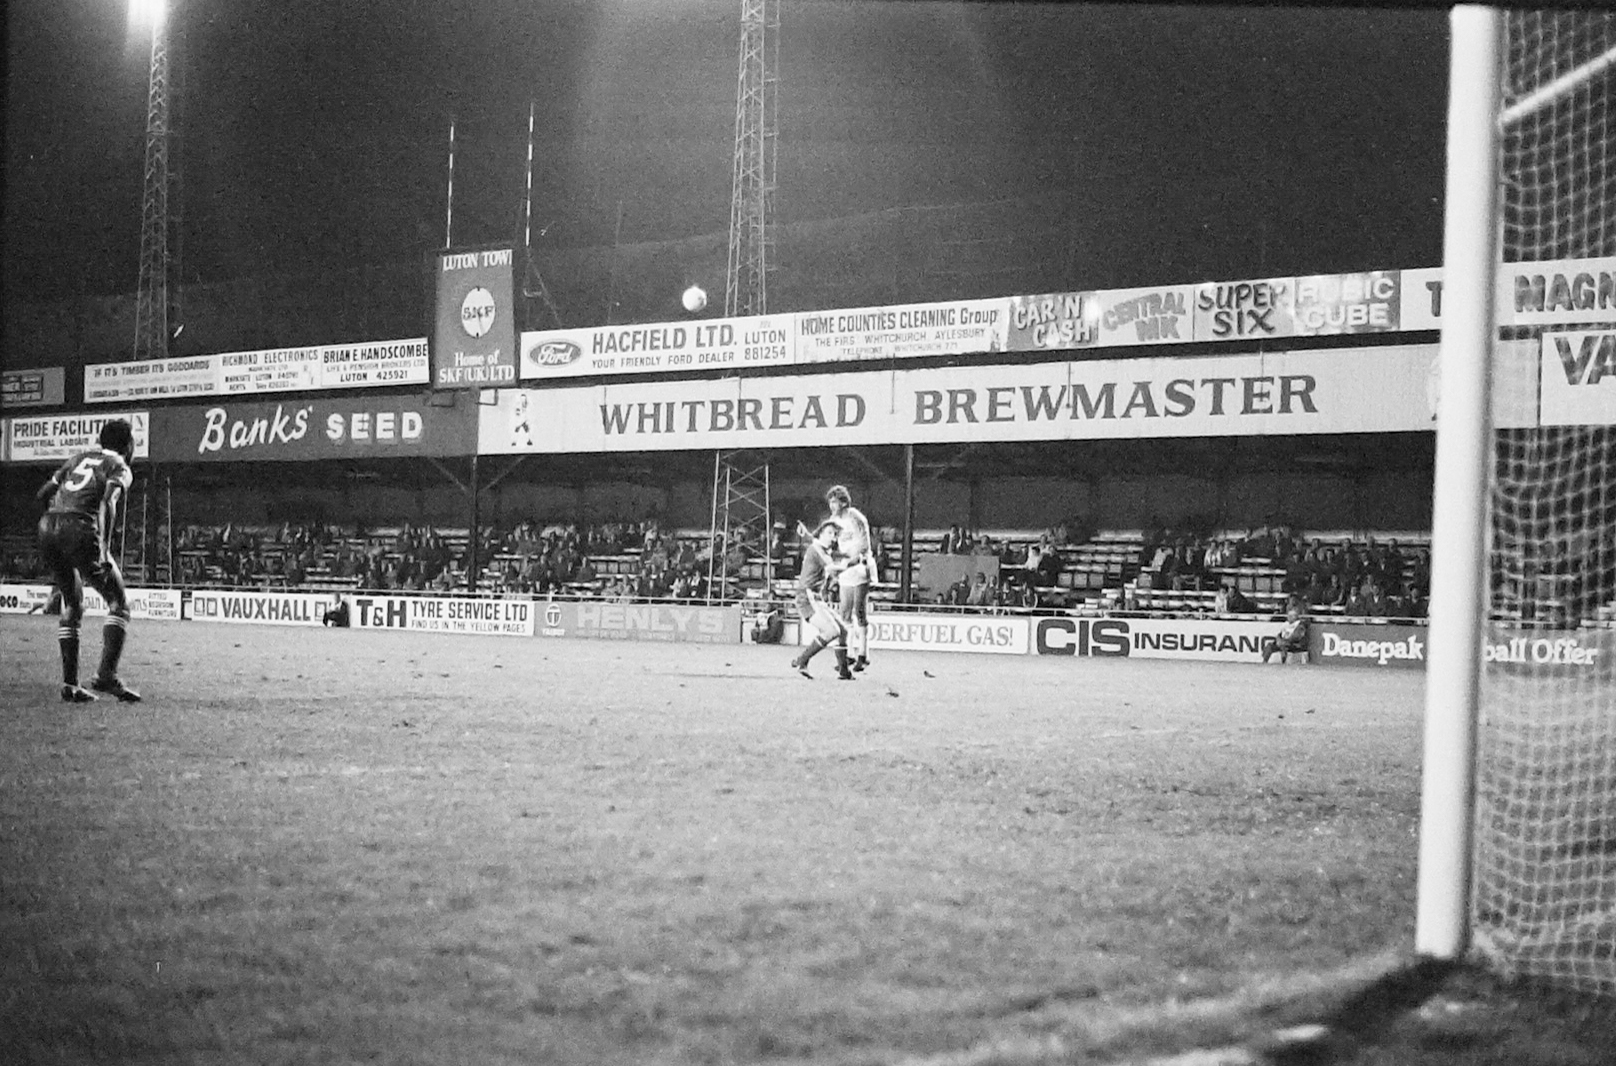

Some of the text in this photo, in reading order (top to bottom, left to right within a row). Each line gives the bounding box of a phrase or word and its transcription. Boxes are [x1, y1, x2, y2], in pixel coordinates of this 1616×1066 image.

[443, 252, 479, 272] LUTON
[801, 307, 998, 336] HOME COUNTIES CLEANING Group
[1213, 308, 1275, 336] SIX
[744, 329, 787, 346] LUTON
[815, 337, 832, 348] THE
[934, 328, 985, 341] AYLESBURY
[264, 349, 319, 364] ELECTRONICS
[323, 349, 350, 363] BRIAN
[360, 343, 427, 361] HANDSCOMBE
[487, 348, 501, 364] of
[537, 343, 574, 364] Ford
[592, 351, 735, 370] YOUR FRIENDLY FORD DEALER
[744, 345, 787, 361] 881254
[340, 370, 408, 382] LUTON 425921
[599, 374, 1319, 435] WHITBREAD BREWMASTER
[14, 419, 107, 438] PRIDE FACILIT
[326, 411, 423, 440] SEED
[65, 457, 104, 492] 5
[221, 597, 312, 622] VAUXHALL
[356, 599, 528, 628] T&H TYRE SERVICE LTD
[411, 619, 526, 633] FIND US IN THE YELLOW PAGES
[867, 622, 1014, 647] DERFUEL GAS!
[1036, 618, 1277, 658] CIS INSURANC
[1321, 632, 1424, 665] Danepak
[1531, 637, 1599, 665] Offer
